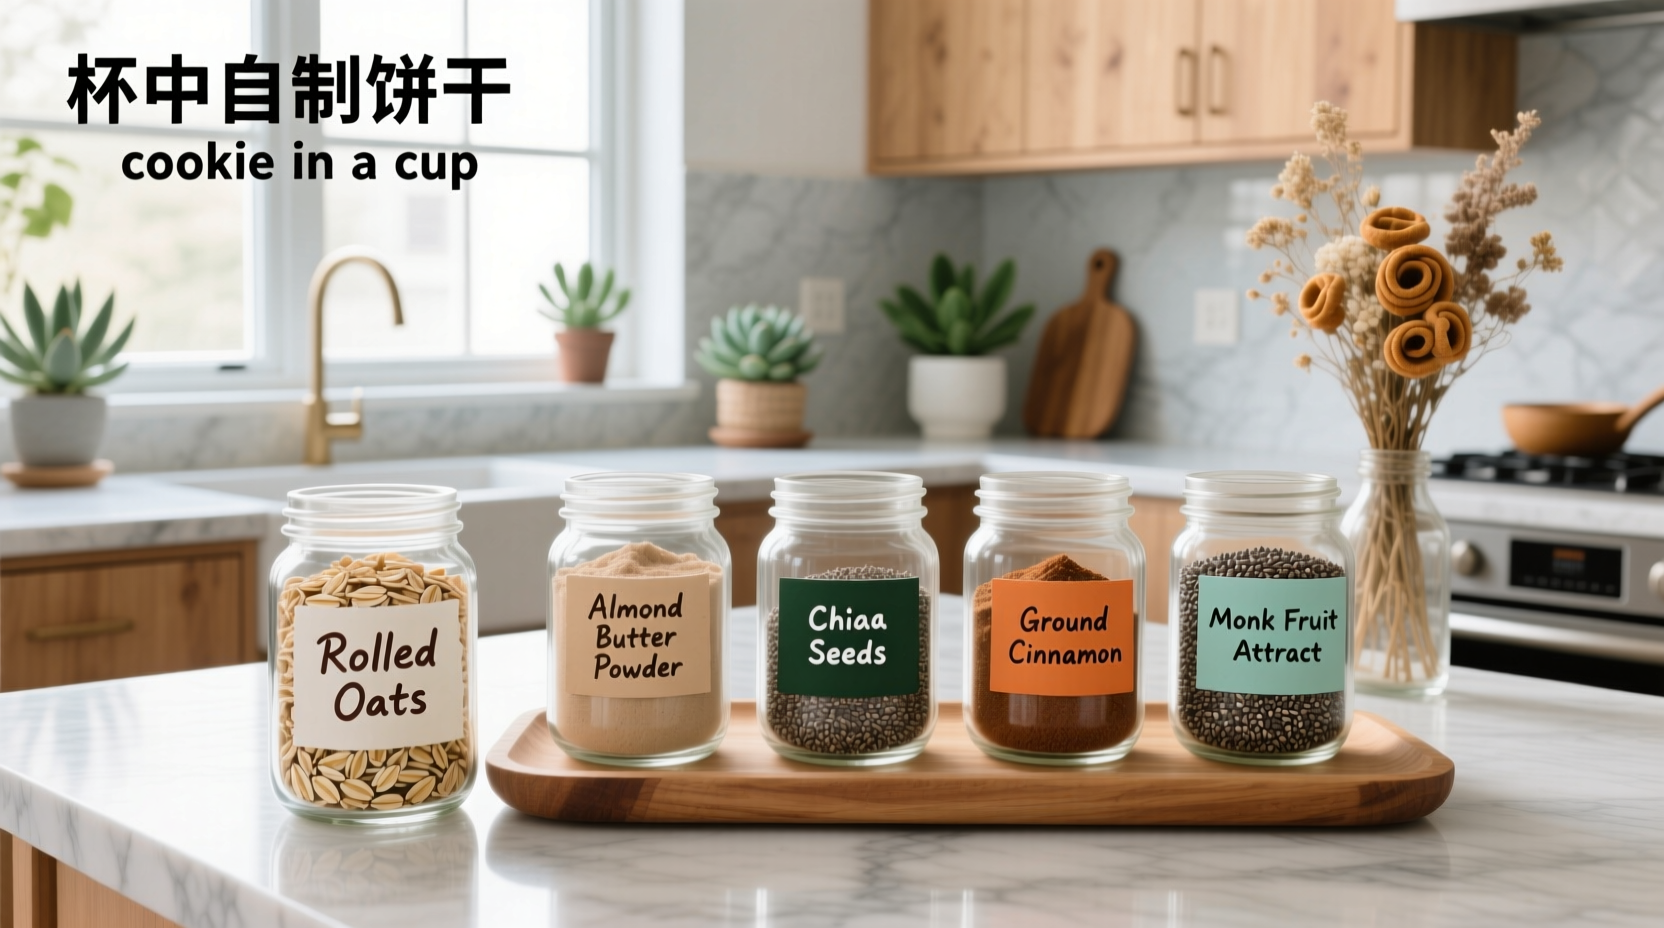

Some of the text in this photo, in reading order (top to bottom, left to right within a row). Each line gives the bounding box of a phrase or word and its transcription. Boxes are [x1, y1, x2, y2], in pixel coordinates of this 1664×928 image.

[587, 592, 684, 620] Almond
[808, 605, 887, 632] Chiaa
[1019, 604, 1109, 633] Ground
[1208, 606, 1339, 632] Monk Fruit
[596, 623, 678, 649] Butter
[316, 626, 439, 675] Rolled
[808, 638, 887, 665] Seeds
[1008, 638, 1122, 665] Cinnamon
[1232, 638, 1323, 663] Attract
[594, 652, 684, 680] Powder
[333, 681, 427, 722] Oats
